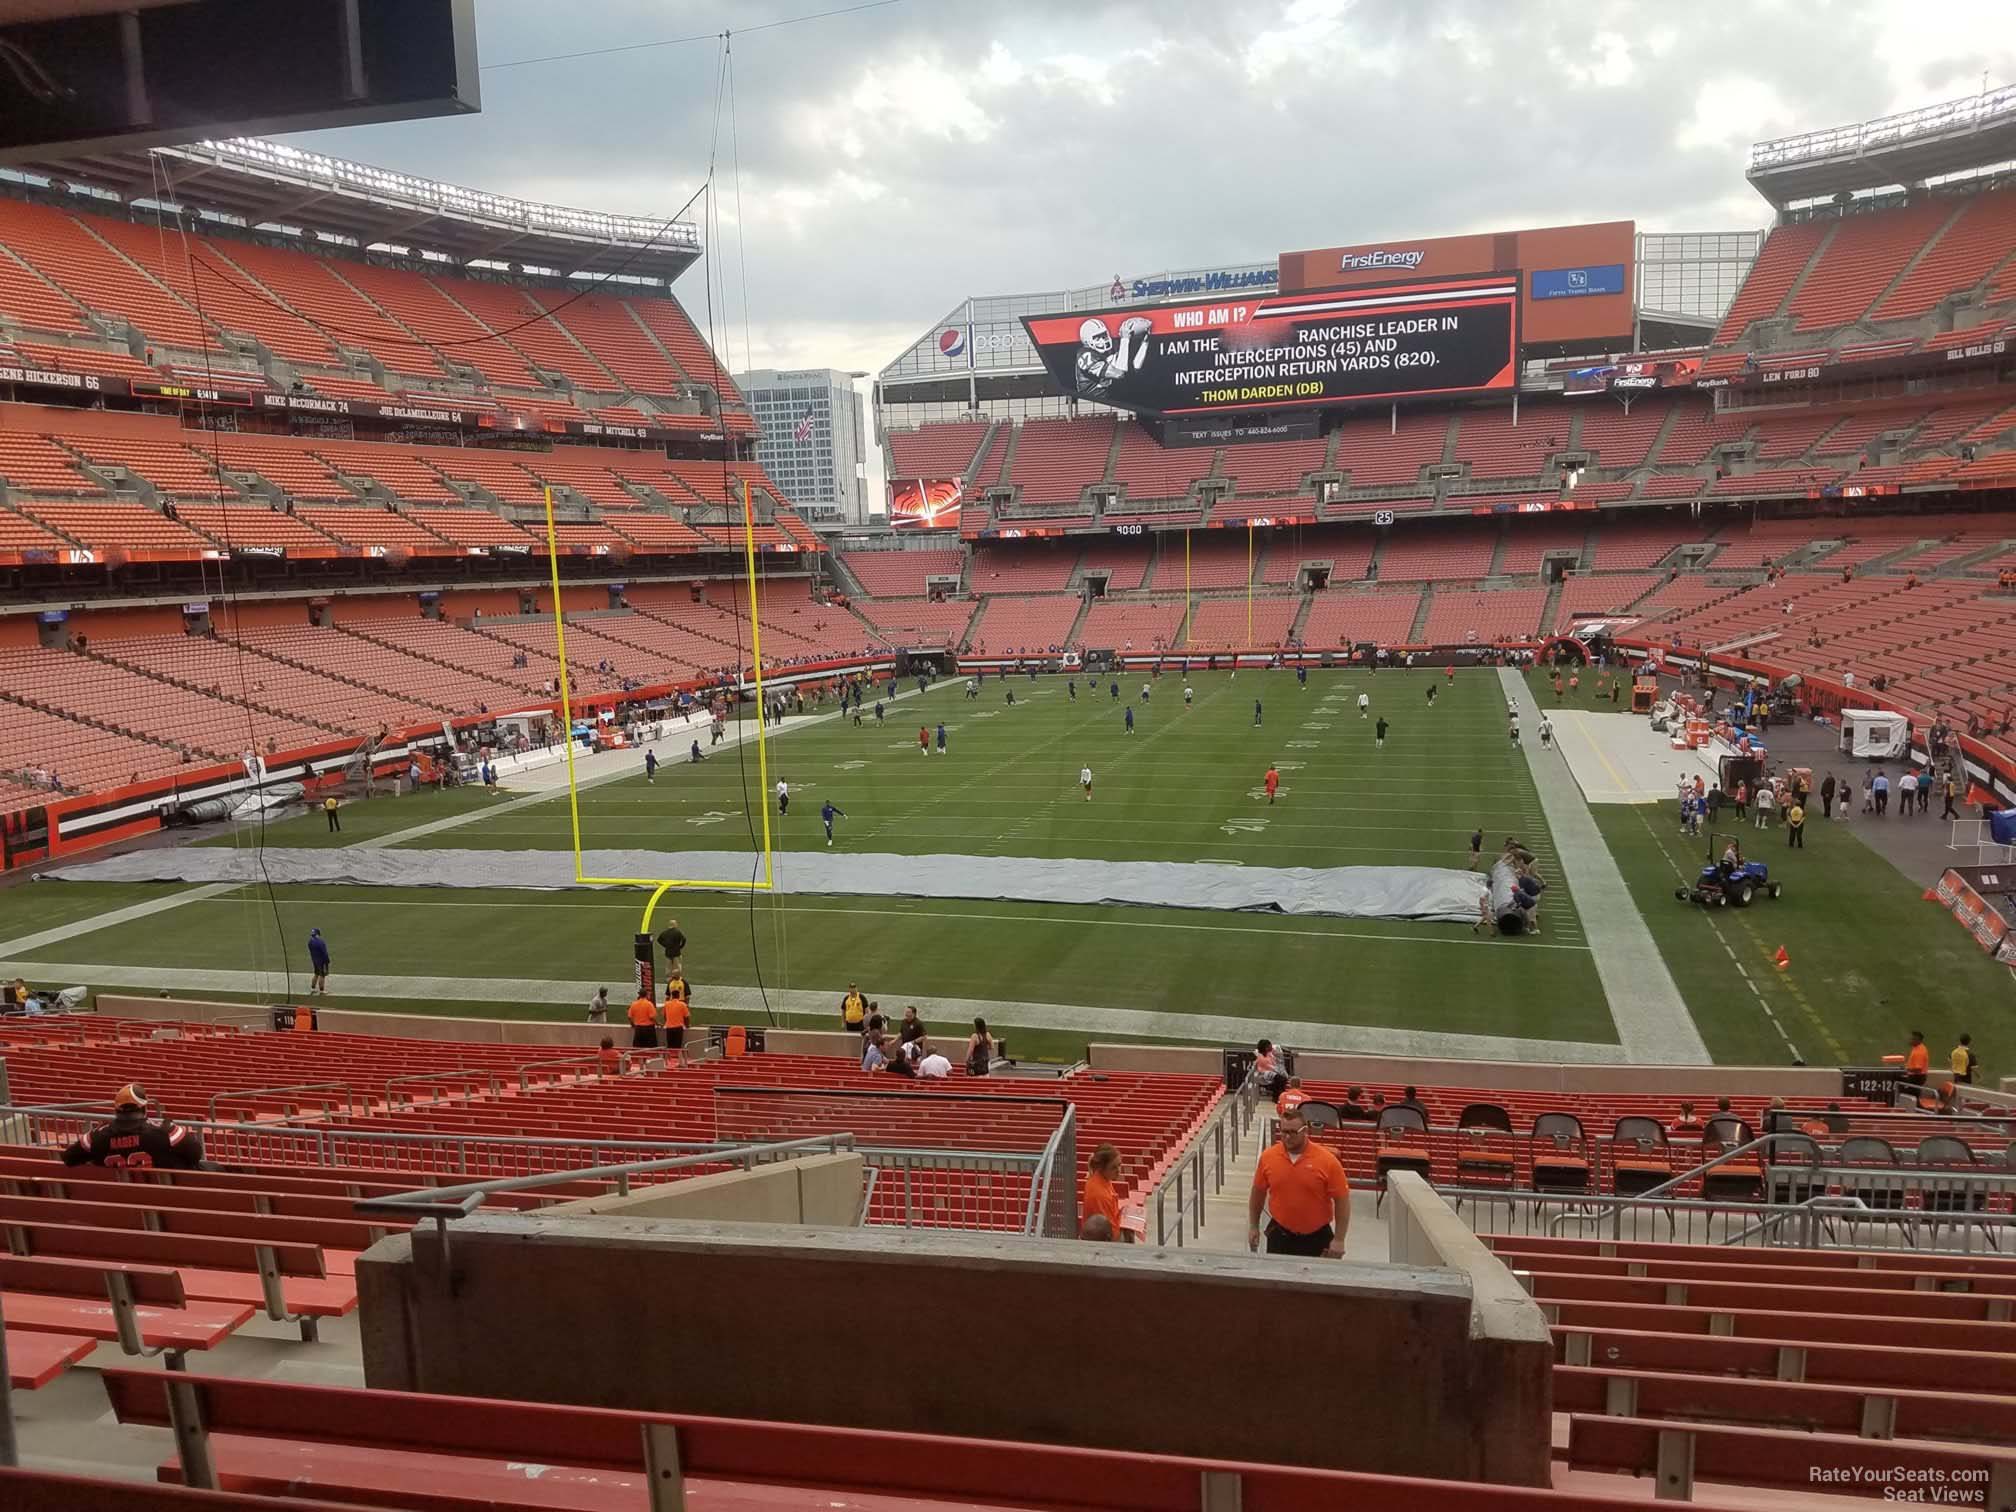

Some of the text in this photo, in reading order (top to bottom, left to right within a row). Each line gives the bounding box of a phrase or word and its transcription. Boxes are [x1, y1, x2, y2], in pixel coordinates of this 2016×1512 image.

[1342, 250, 1424, 268] FirstEnergy
[1132, 270, 1279, 297] SHERWIN-WILLIAMS
[1173, 306, 1247, 328] WHO AM I?
[1160, 343, 1163, 356] I
[1167, 339, 1190, 355] AM
[1192, 337, 1219, 353] THE
[1297, 323, 1376, 344] RANCHISE
[1379, 318, 1438, 336] LEADER
[1442, 316, 1459, 331] IN
[1215, 338, 1397, 367] INTERCEPTIONS (45) AND
[1947, 348, 1964, 360] BILL
[1966, 344, 1992, 358] WILLIS
[1175, 351, 1440, 386] INTERCEPTION RETURN YARDS (820).
[1763, 372, 1781, 383] LEN
[1785, 369, 1805, 380] FORD
[25, 370, 81, 387] HICKERSON
[85, 375, 100, 390] 66
[1614, 377, 1656, 387] FirstEnergy
[1697, 378, 1728, 388] KeyBank
[1201, 388, 1238, 403] THOM
[1241, 384, 1293, 400] DARDEN
[1296, 381, 1324, 397] (DB)
[264, 394, 349, 413] MIKE McCORMACK 74
[379, 406, 393, 417] JOE
[1192, 431, 1207, 439] TEXT
[1211, 429, 1232, 438] ISSUES
[1235, 429, 1244, 437] TO
[1377, 512, 1391, 523] 25
[1116, 525, 1142, 535] 90:00
